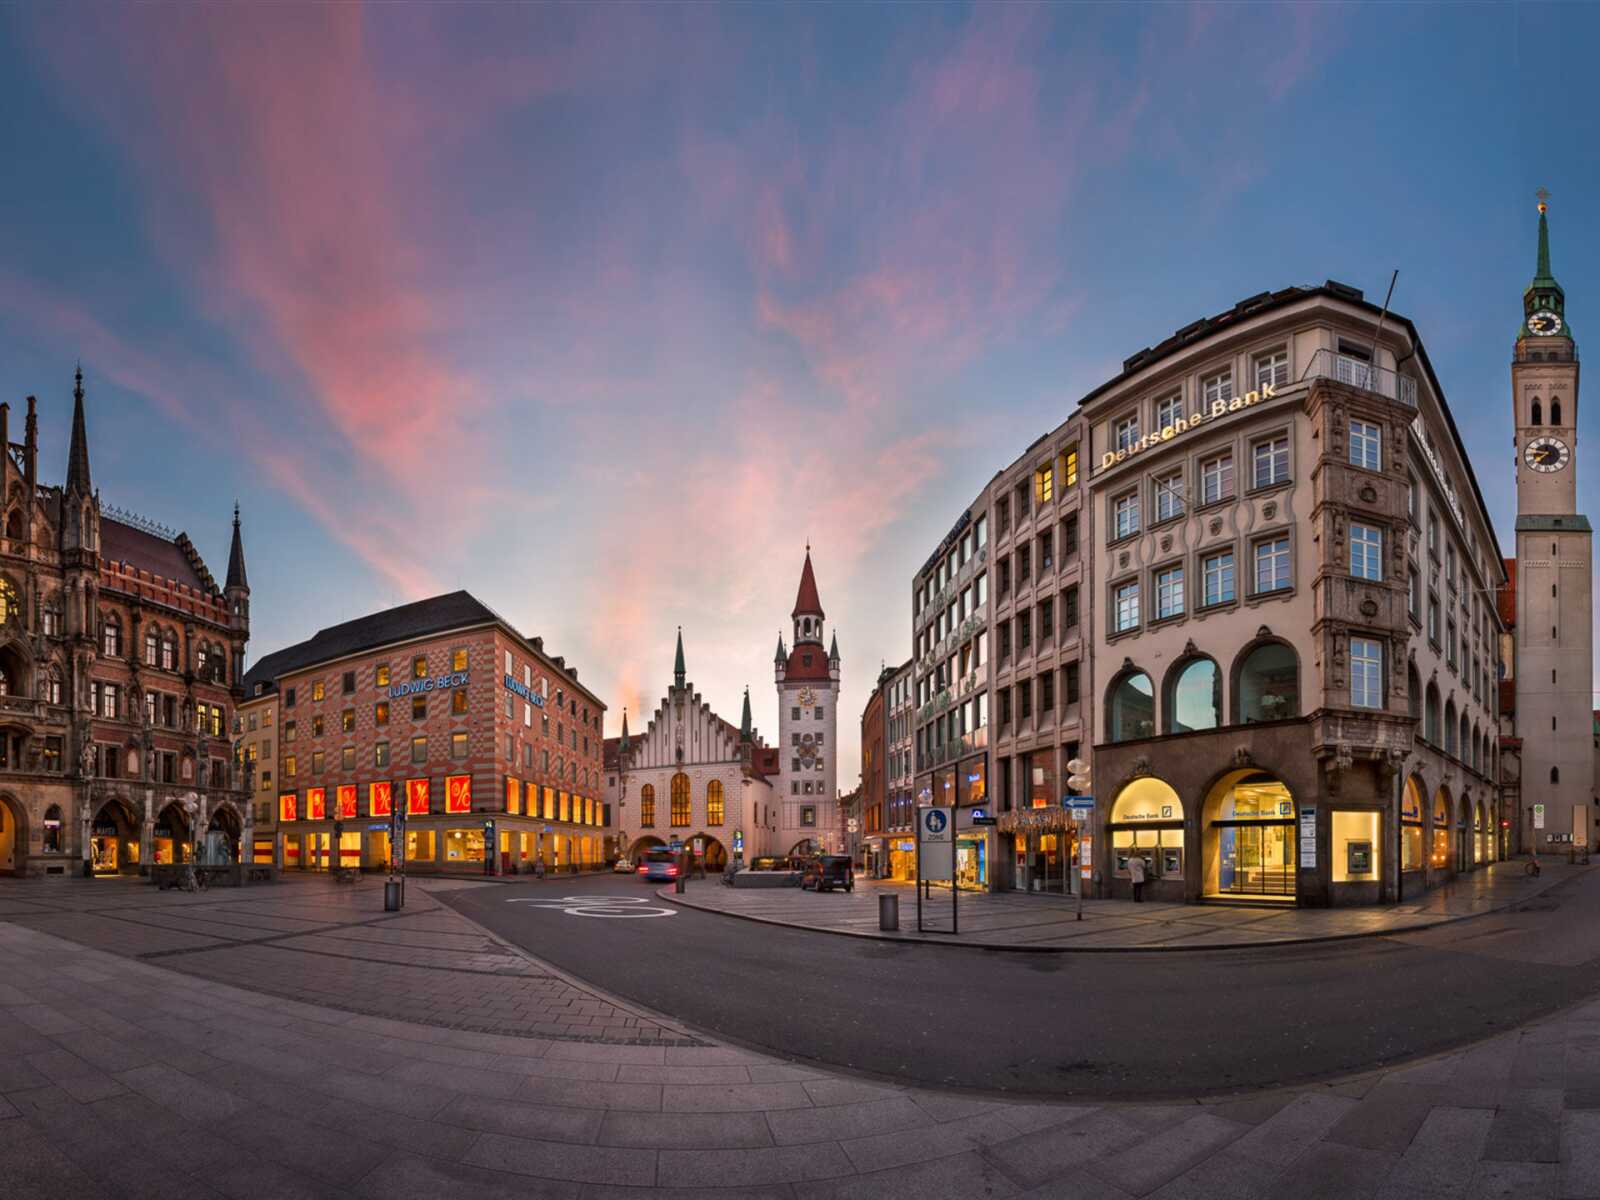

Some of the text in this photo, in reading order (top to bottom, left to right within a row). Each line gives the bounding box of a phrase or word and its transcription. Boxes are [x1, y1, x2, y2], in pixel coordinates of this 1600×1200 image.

[1103, 381, 1277, 469] Deutsche Bank
[389, 672, 470, 698] LUDWIG BECK
